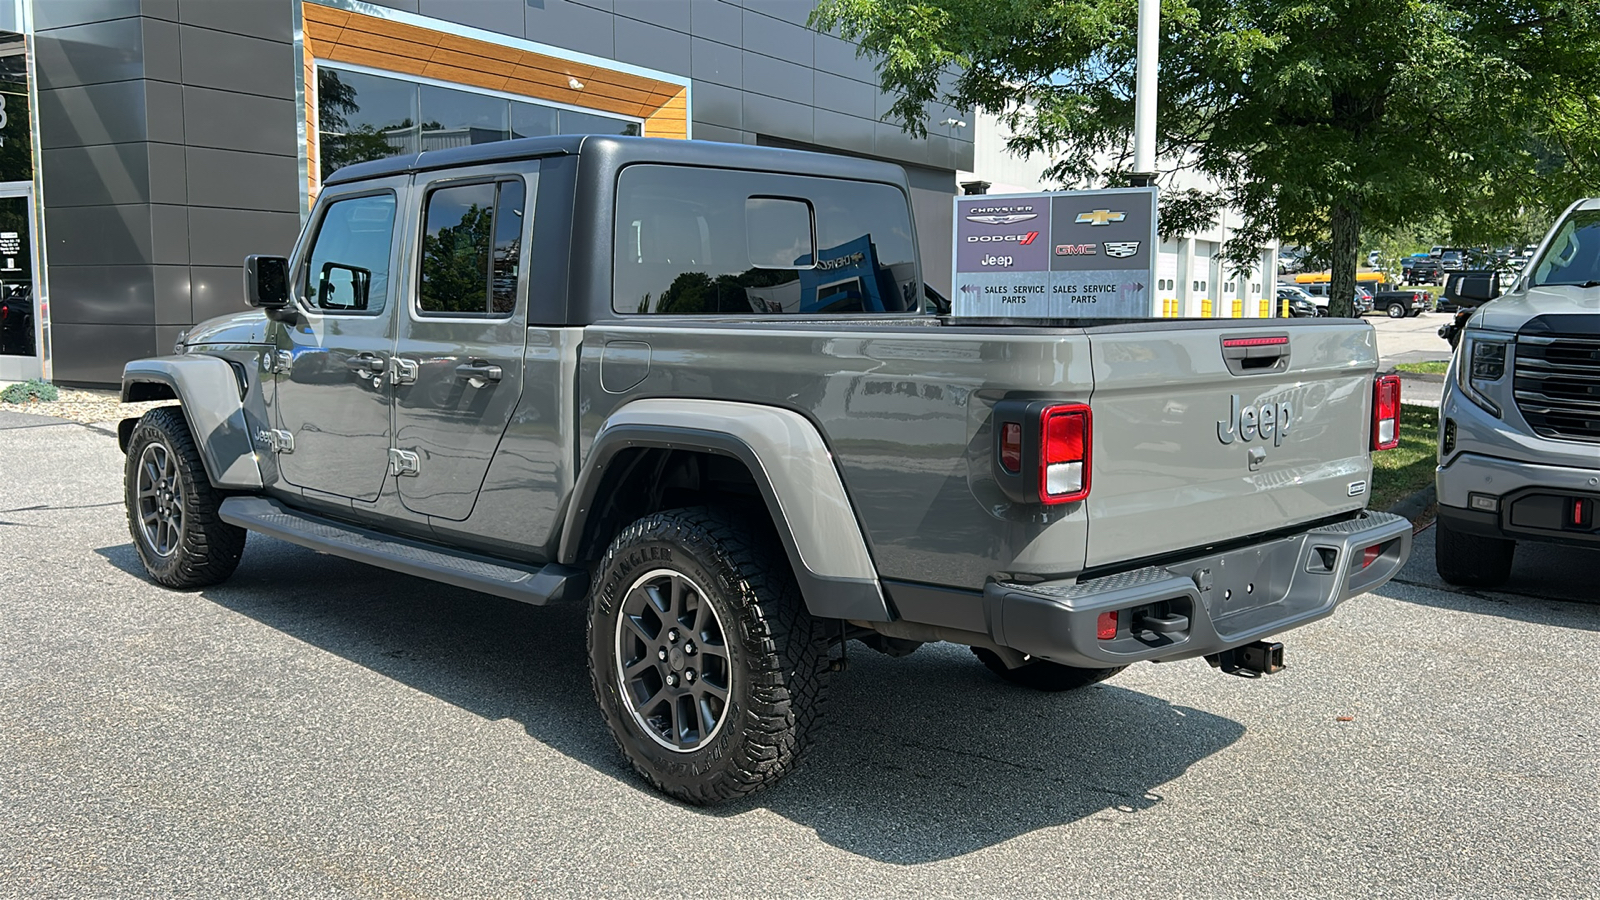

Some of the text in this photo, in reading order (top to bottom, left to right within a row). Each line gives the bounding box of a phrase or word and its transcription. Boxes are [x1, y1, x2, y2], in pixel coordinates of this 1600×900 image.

[970, 206, 1033, 214] CHRYSLER
[967, 235, 1028, 243] DODGE
[1055, 244, 1097, 255] GMC
[981, 254, 1013, 267] Jeep
[984, 285, 1046, 294] SALES SERVICE
[1053, 284, 1117, 294] SALES SERVICE
[1002, 296, 1026, 304] PARTS
[1071, 295, 1097, 304] PARTS
[1216, 394, 1294, 447] Jeep
